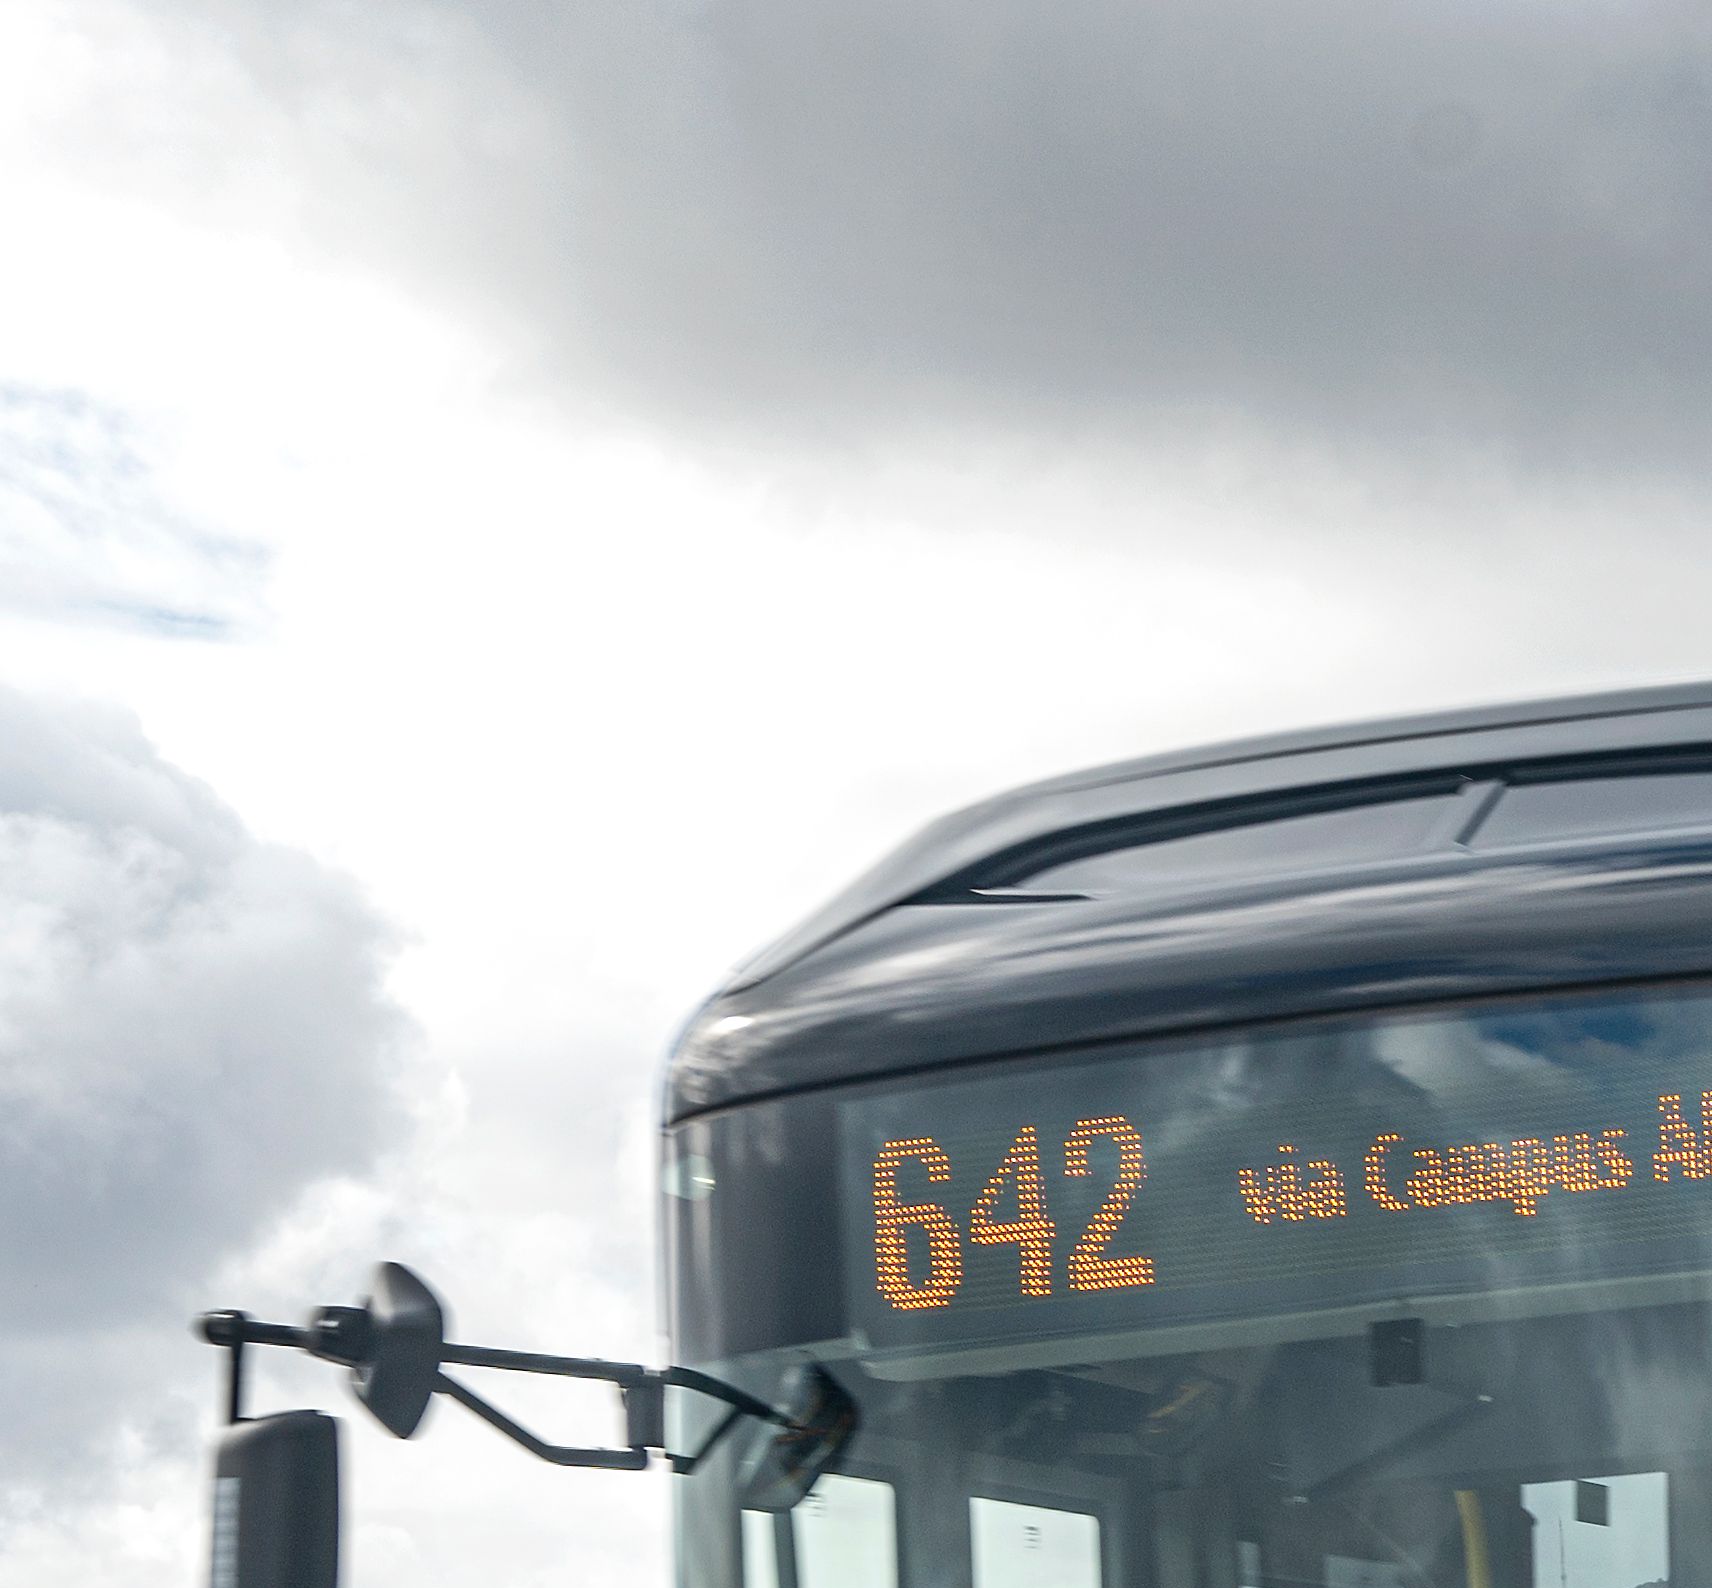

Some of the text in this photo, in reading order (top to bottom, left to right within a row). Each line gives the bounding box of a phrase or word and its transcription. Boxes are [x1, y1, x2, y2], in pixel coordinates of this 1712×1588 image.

[871, 1114, 1156, 1311] 642
[1238, 1144, 1347, 1224] via
[1363, 1129, 1635, 1217] Campus
